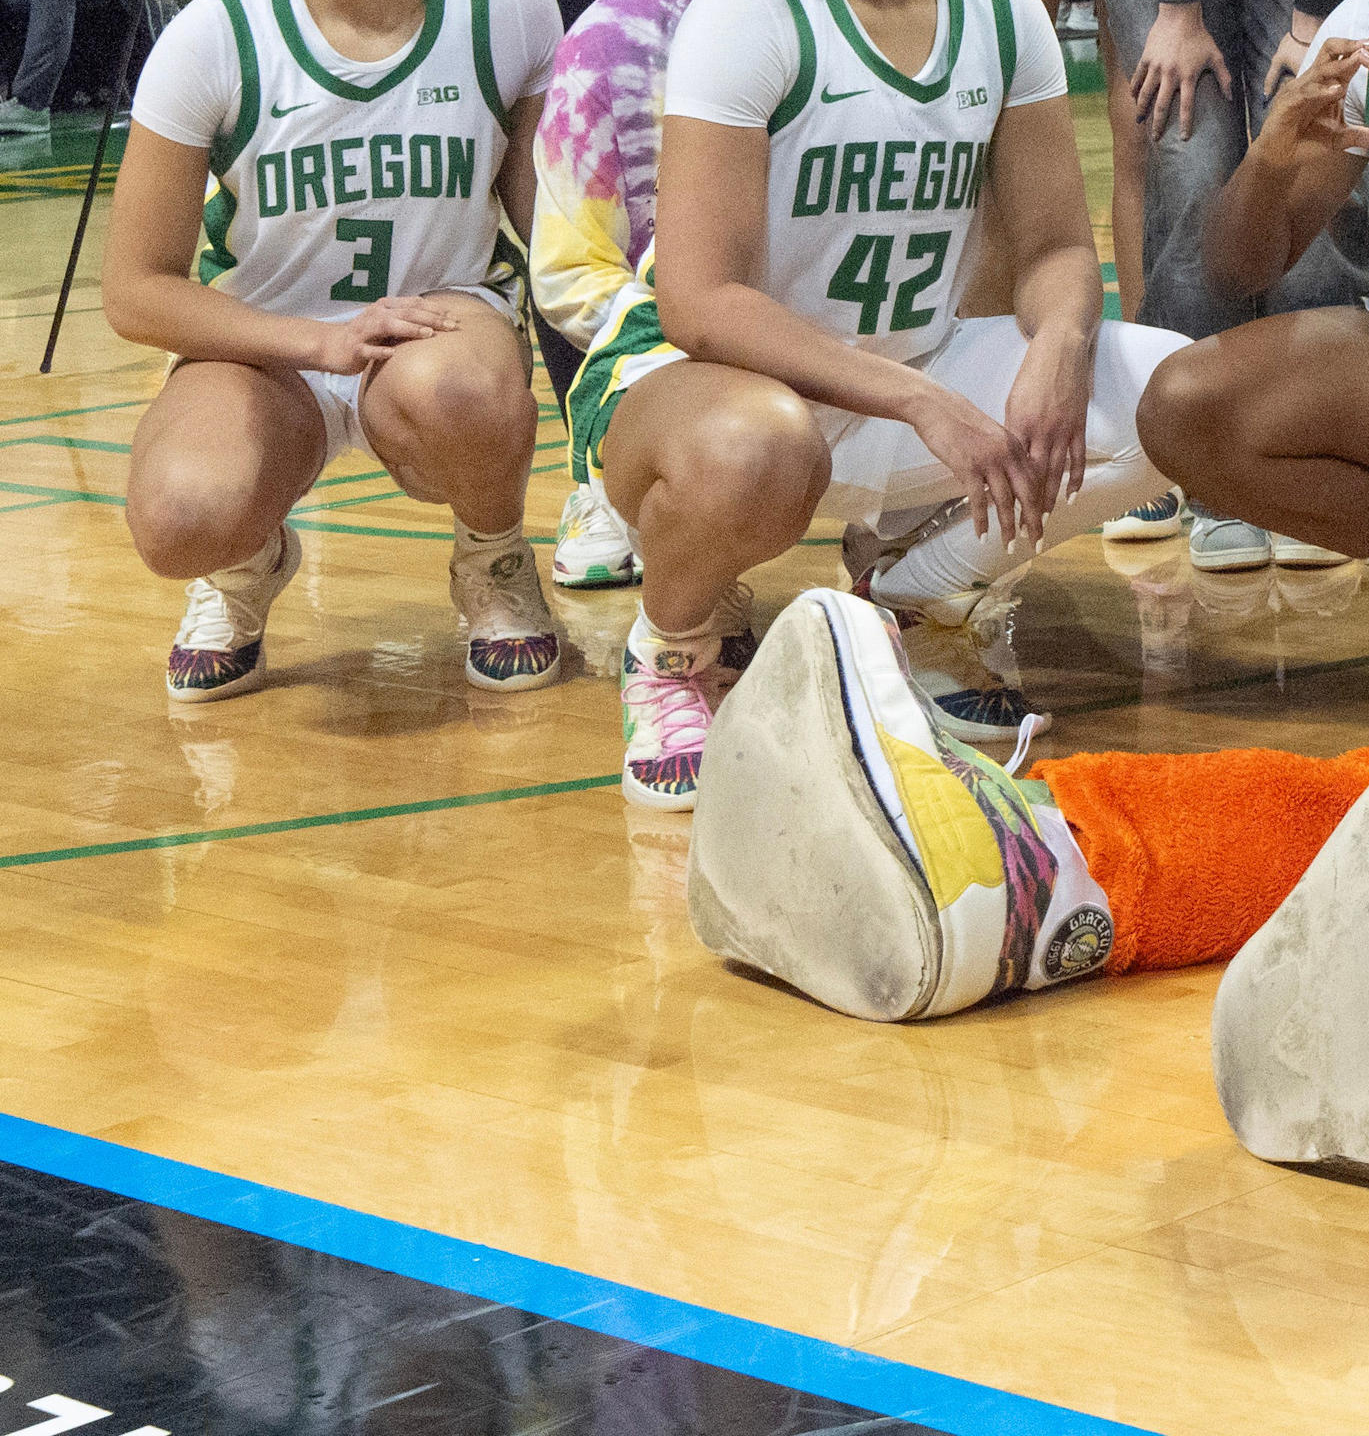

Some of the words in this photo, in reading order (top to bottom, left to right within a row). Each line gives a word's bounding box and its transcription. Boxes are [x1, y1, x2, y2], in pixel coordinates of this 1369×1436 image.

[256, 134, 475, 218] OREGON
[791, 141, 989, 218] OREGON
[330, 217, 394, 302] 3
[826, 231, 952, 335] 42
[1069, 911, 1111, 957] GRATEFUL
